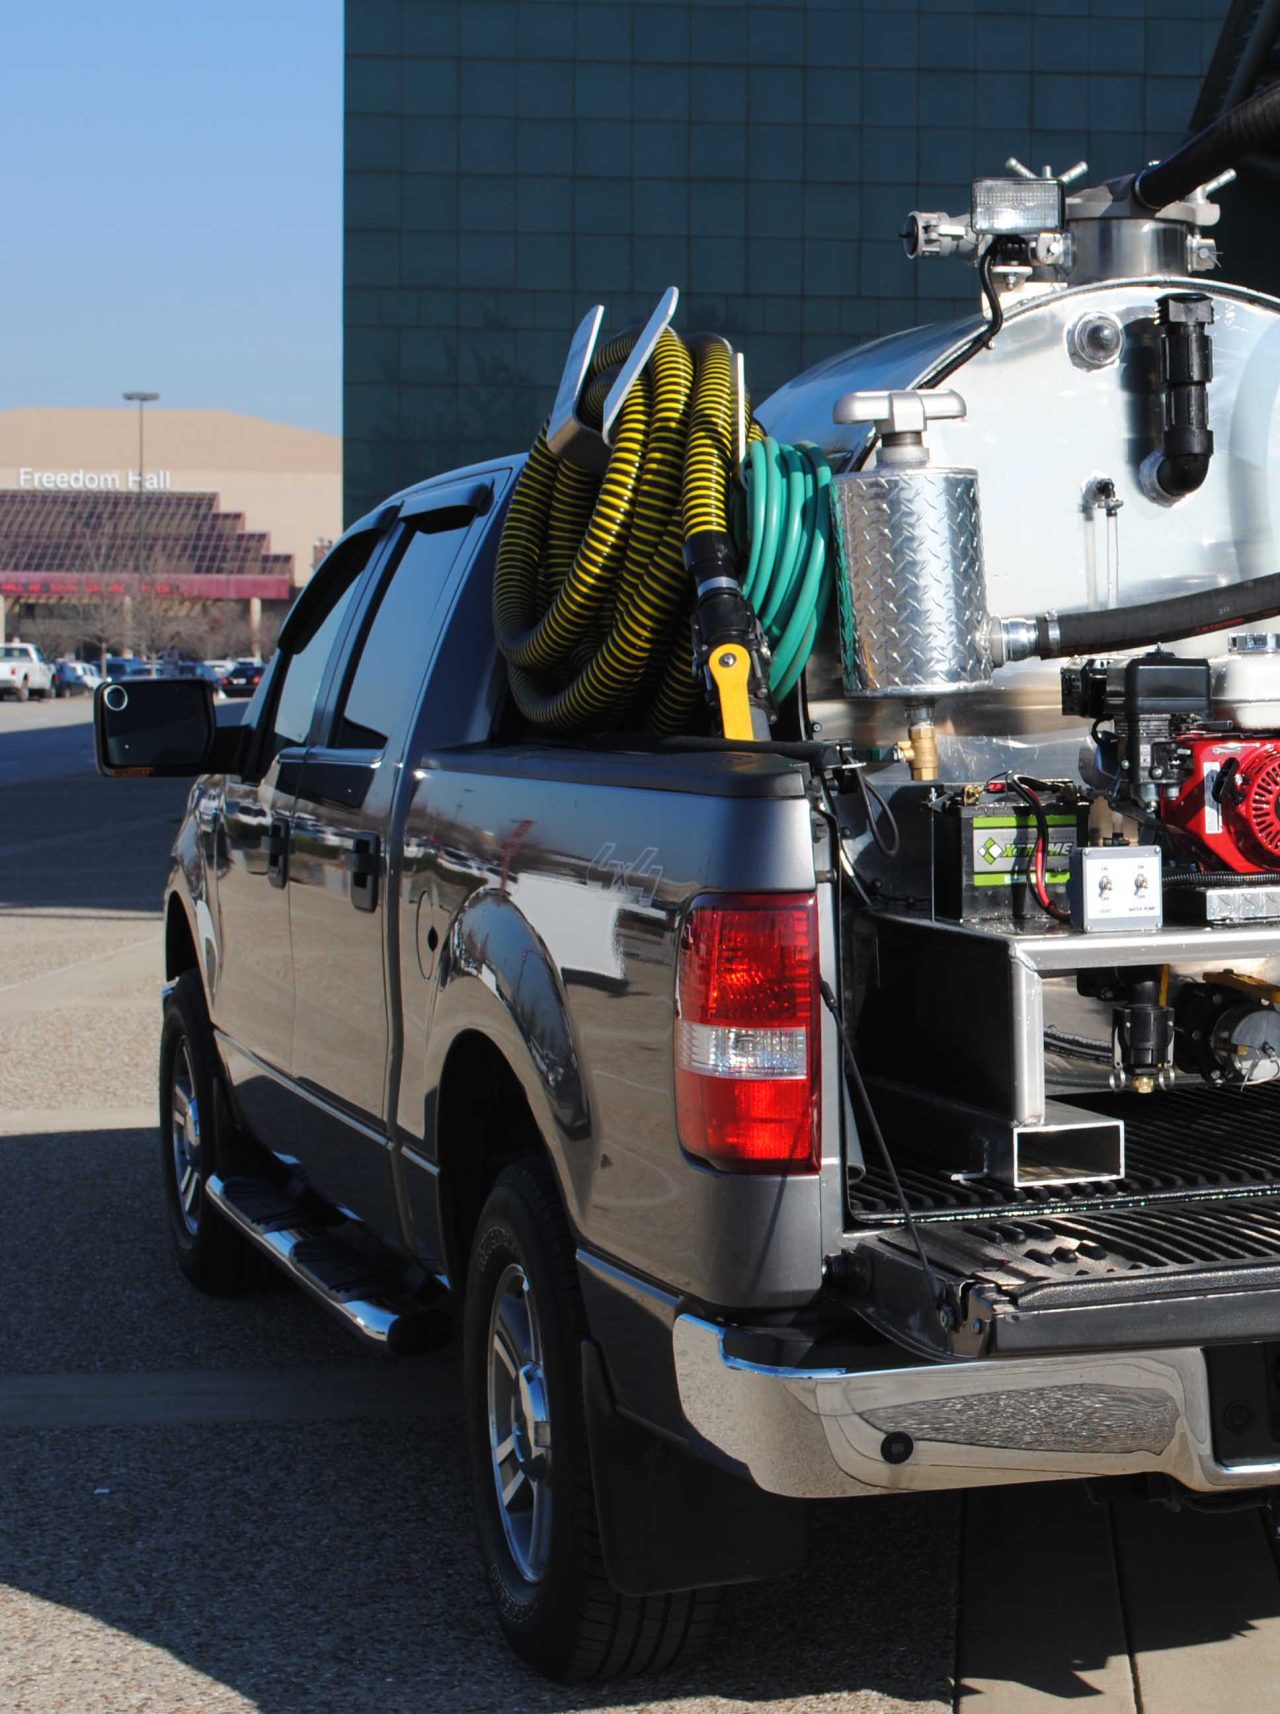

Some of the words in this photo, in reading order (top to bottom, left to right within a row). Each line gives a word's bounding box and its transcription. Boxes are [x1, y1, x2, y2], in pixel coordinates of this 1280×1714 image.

[19, 467, 120, 488] Freedom
[128, 469, 171, 489] Hall
[1002, 842, 1074, 858] XTRME
